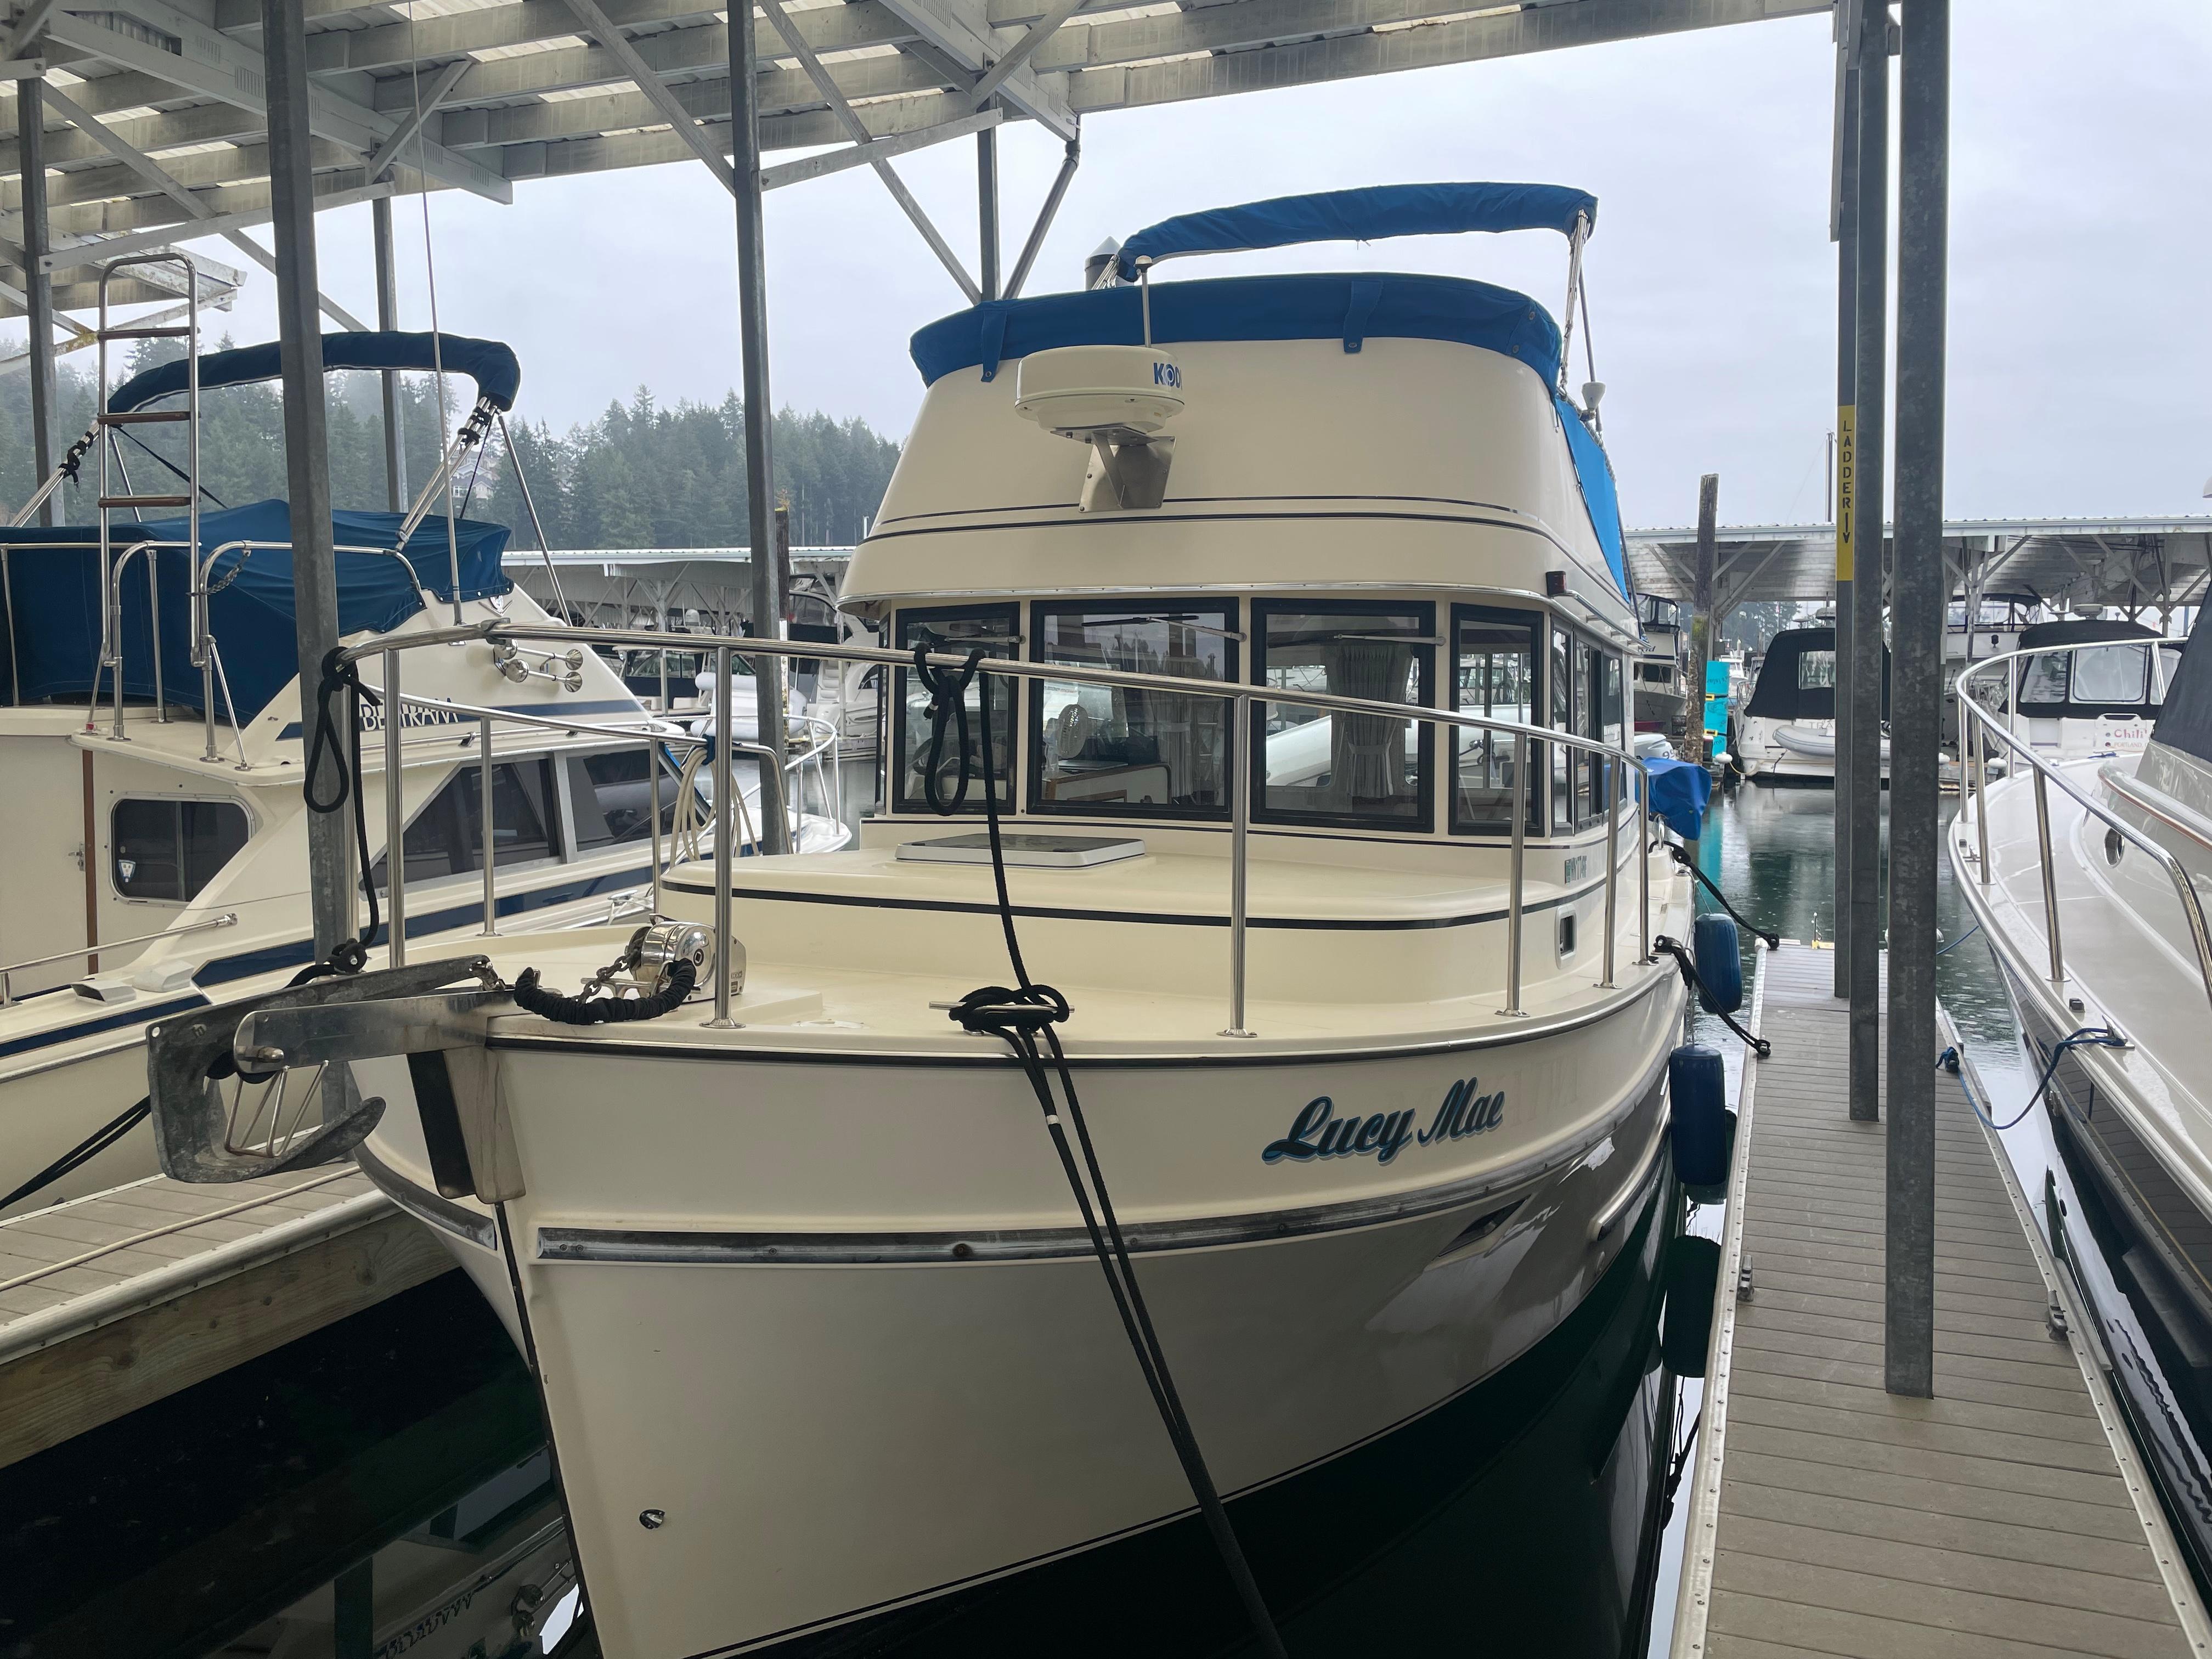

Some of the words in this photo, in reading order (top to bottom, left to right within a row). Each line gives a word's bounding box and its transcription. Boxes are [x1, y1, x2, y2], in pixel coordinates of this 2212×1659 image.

[1153, 362, 1182, 391] KOD
[1842, 420, 1852, 509] LADDER
[1261, 1096, 1416, 1166] Lucy
[1417, 1076, 1505, 1147] Mae
